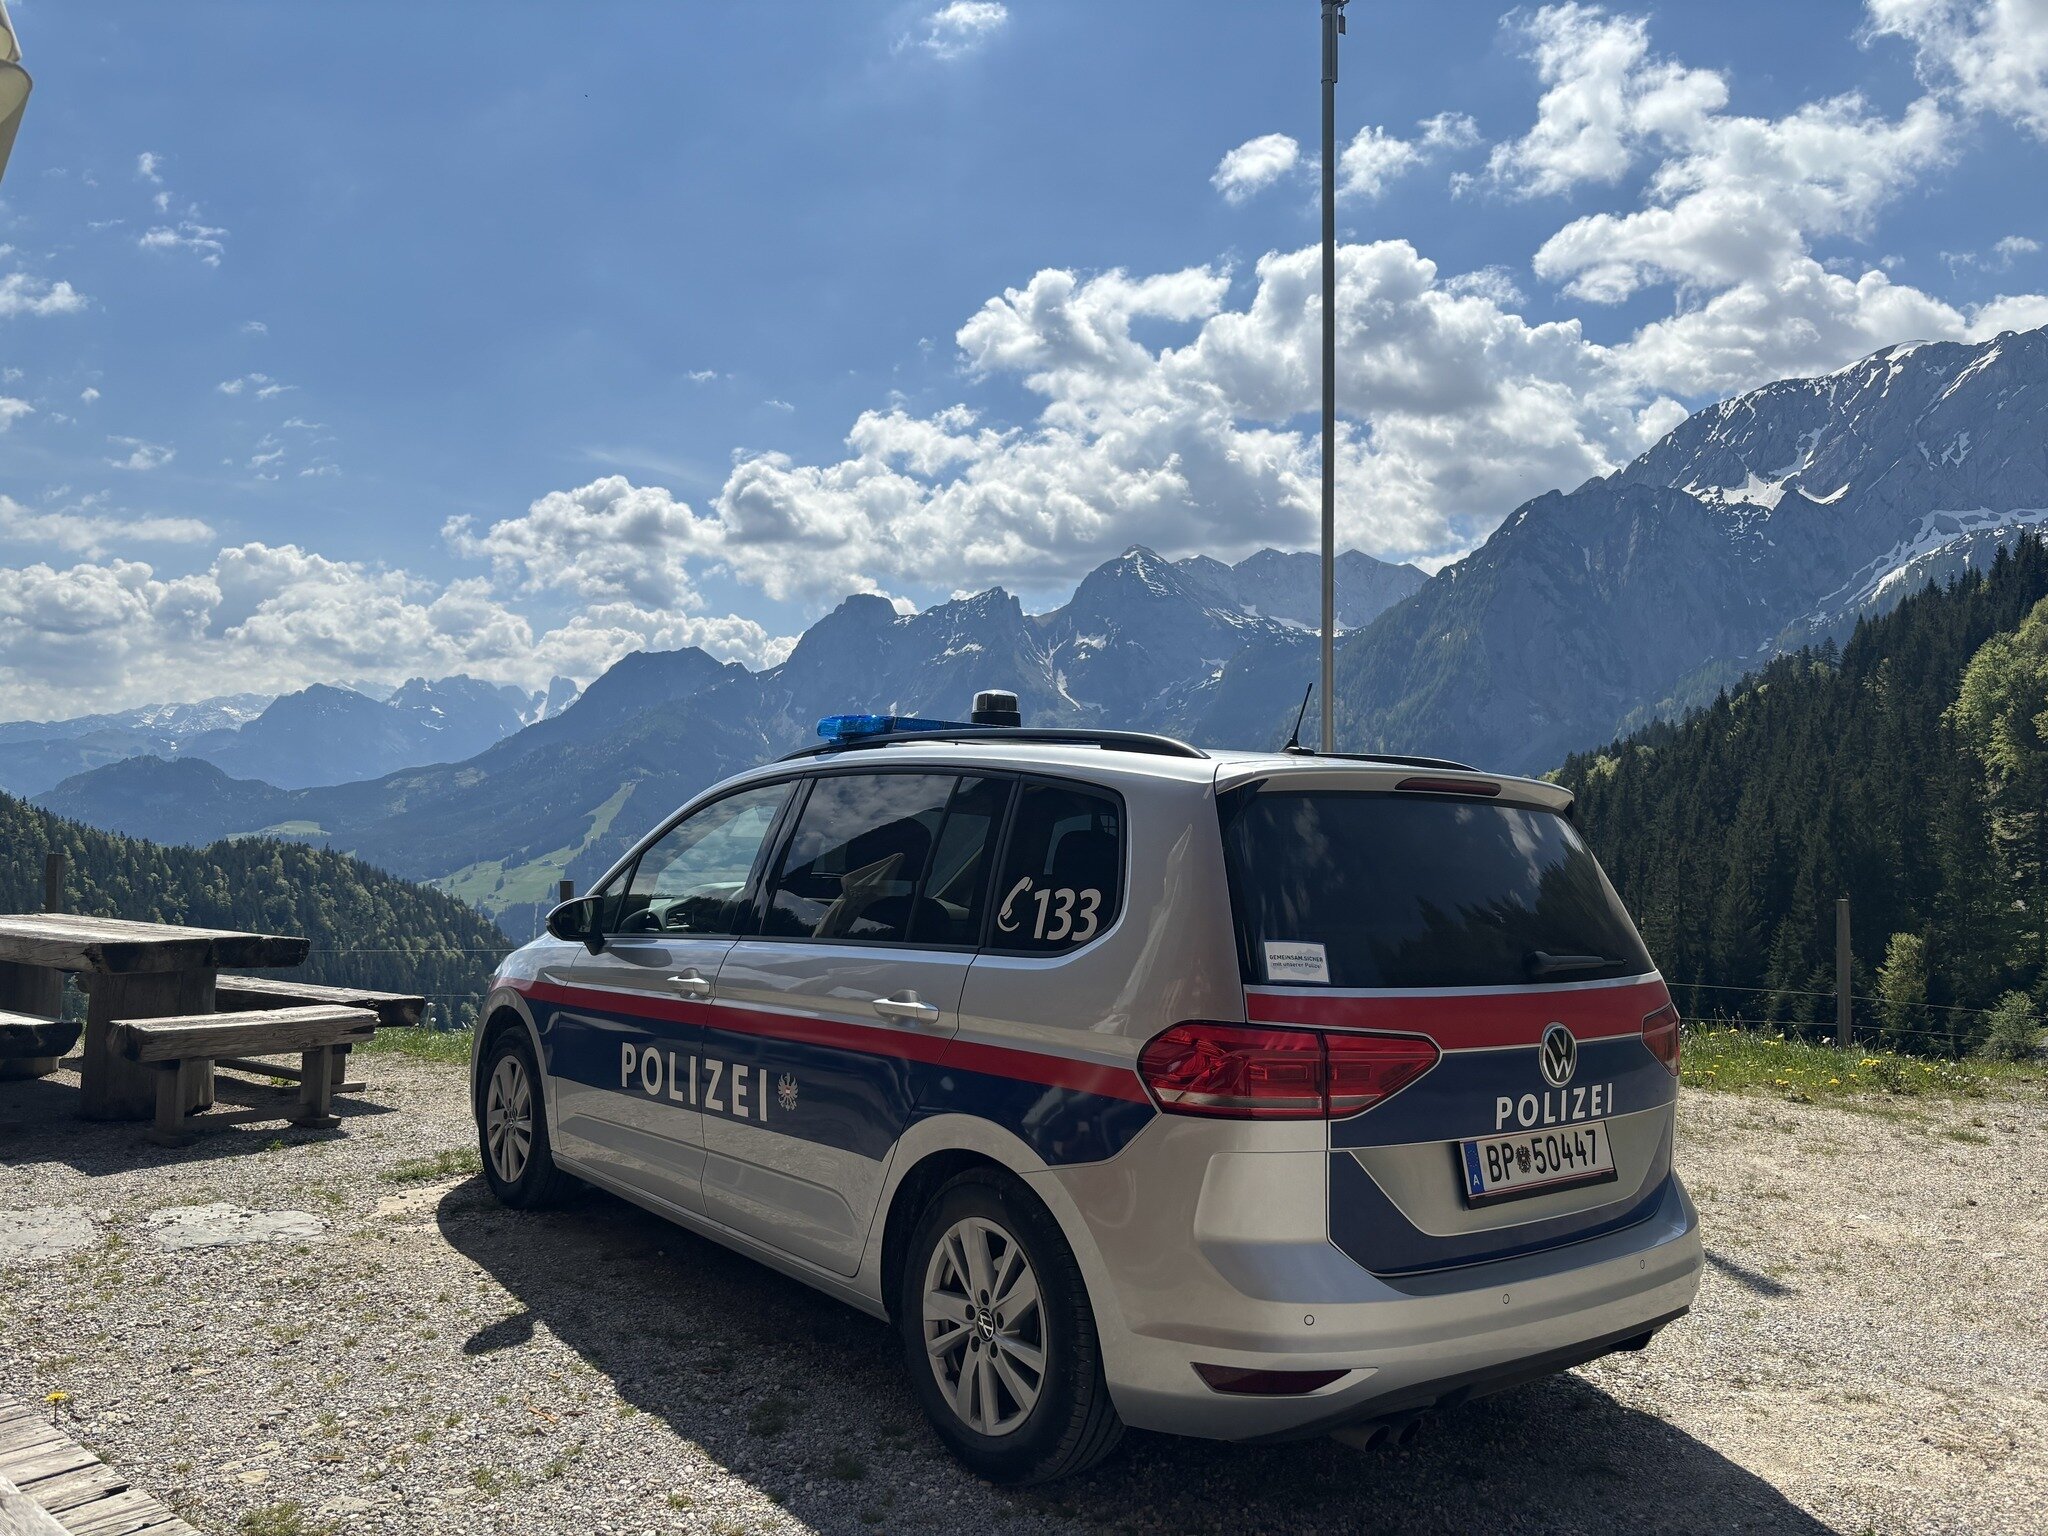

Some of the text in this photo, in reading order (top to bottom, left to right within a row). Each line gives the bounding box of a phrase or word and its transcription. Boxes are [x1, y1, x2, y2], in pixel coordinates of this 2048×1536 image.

[1034, 888, 1102, 941] 133
[621, 1042, 768, 1122] POLIZEI
[1541, 1026, 1576, 1085] VW
[1495, 1082, 1613, 1130] POLIZEI
[1472, 1174, 1481, 1186] A
[1485, 1129, 1596, 1182] BP 50447
